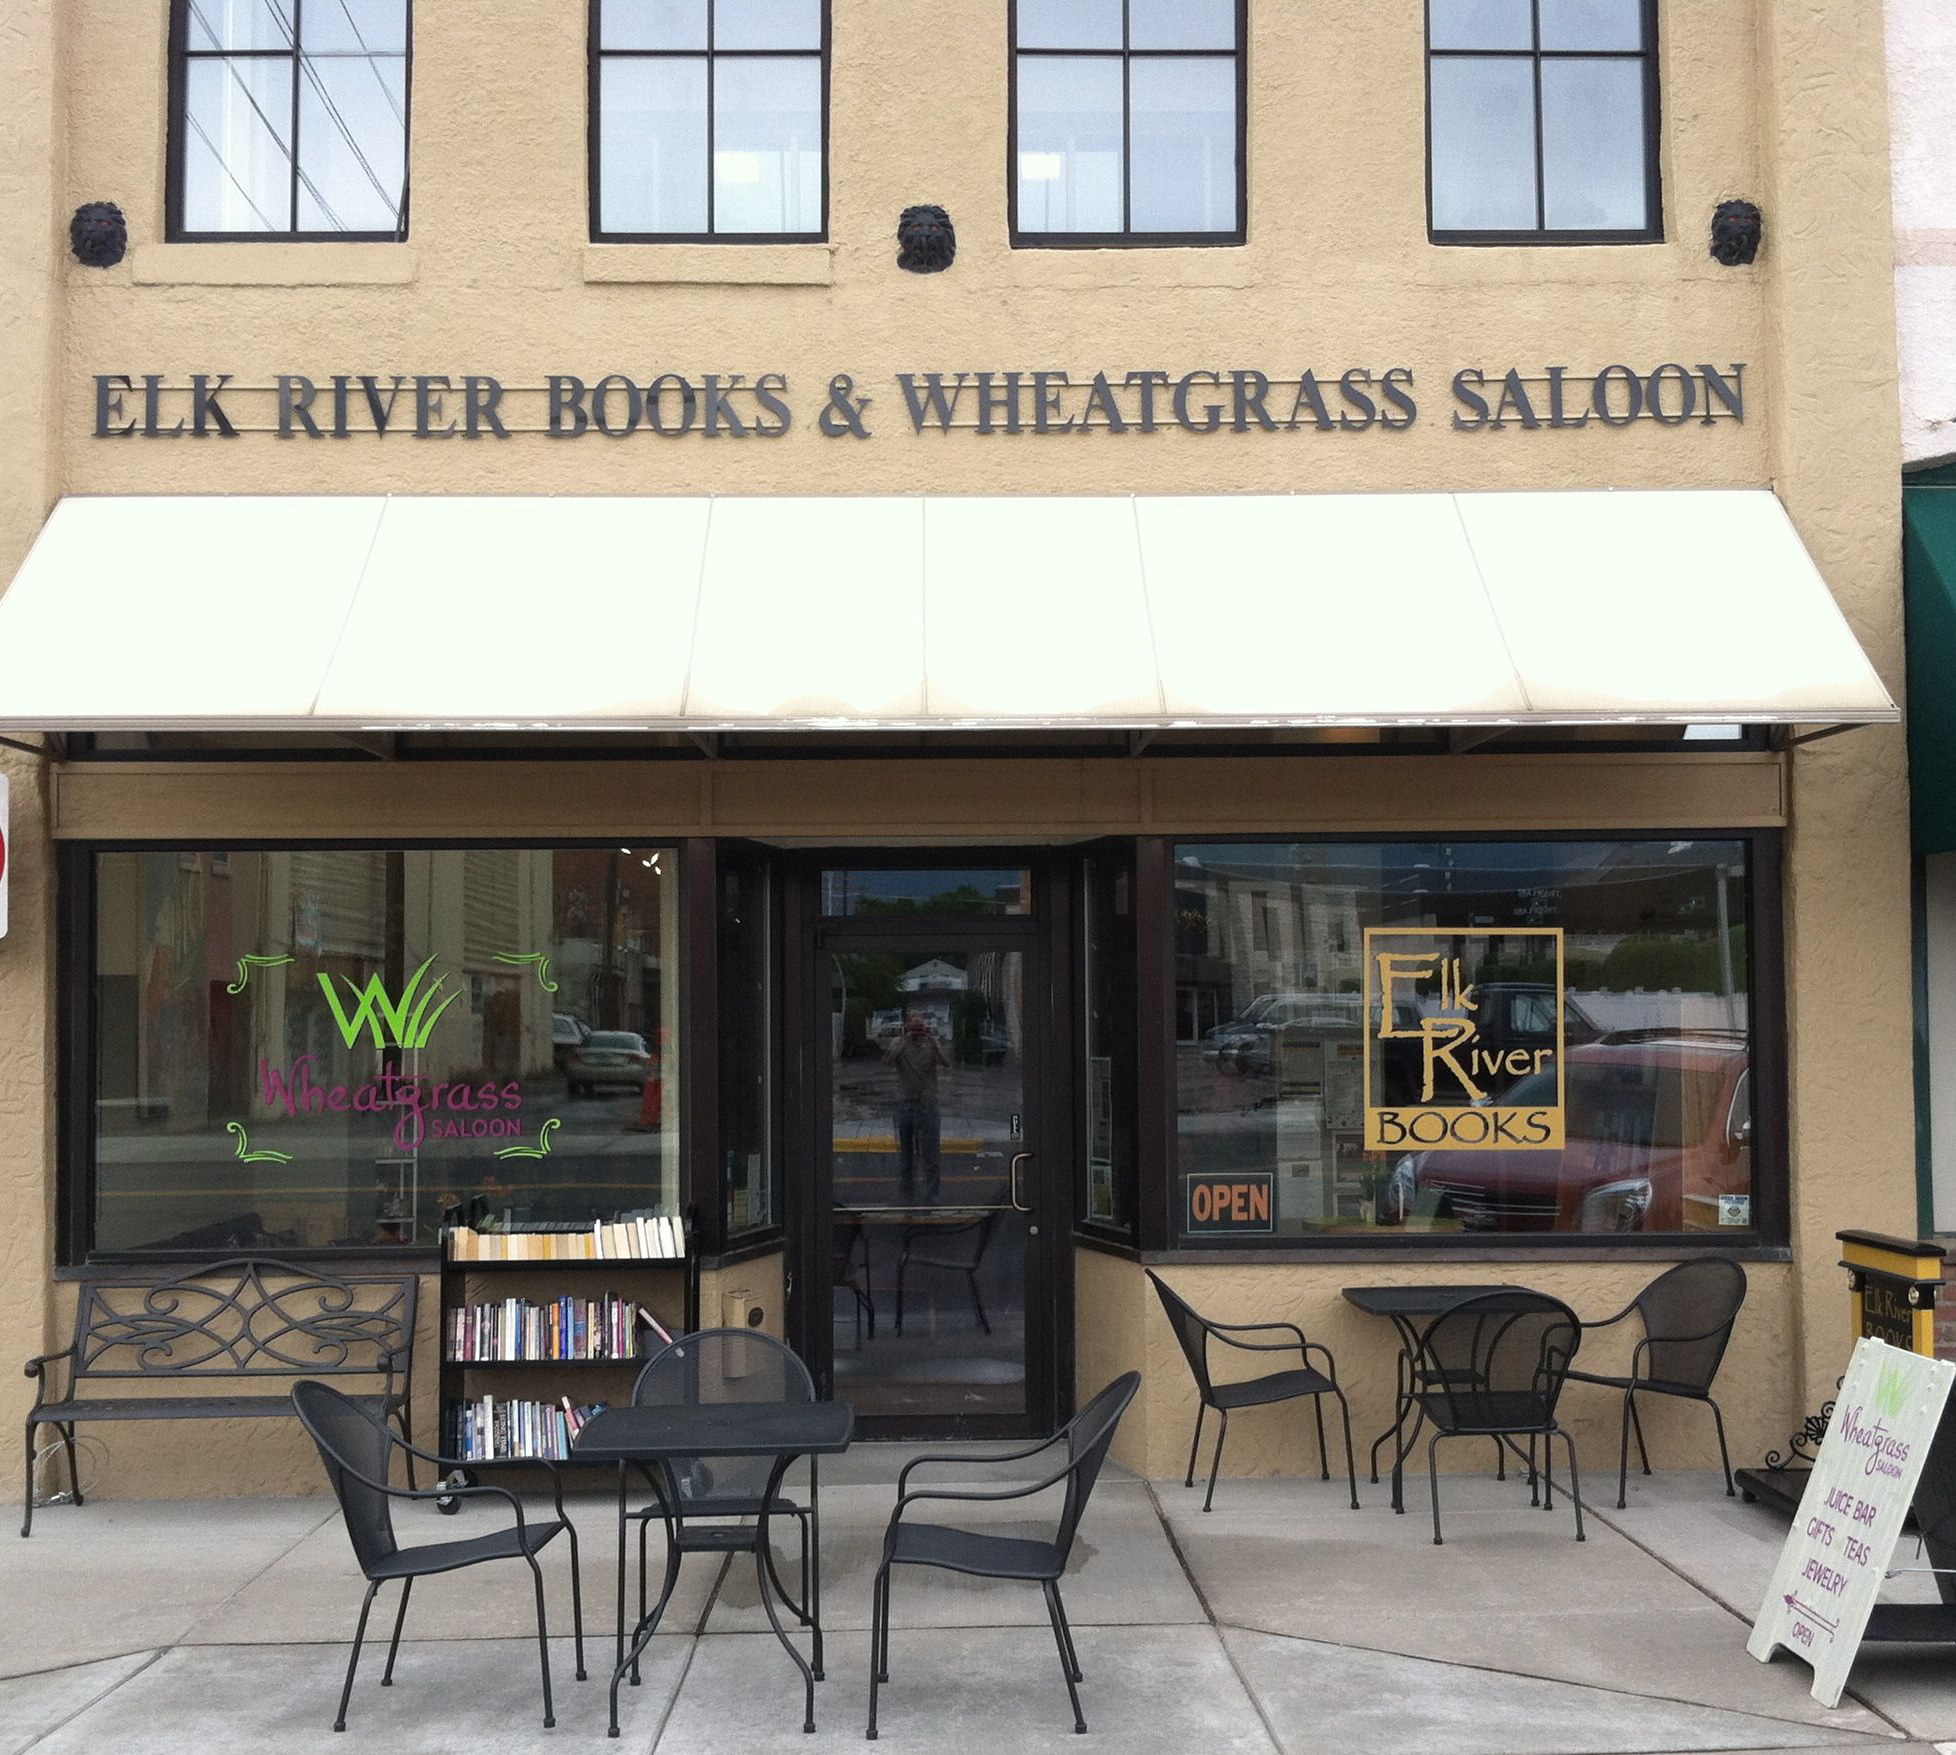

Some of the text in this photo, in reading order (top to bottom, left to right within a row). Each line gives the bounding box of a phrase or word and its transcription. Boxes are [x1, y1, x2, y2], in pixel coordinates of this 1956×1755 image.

[92, 362, 1747, 440] ELK RIVER BOOKS & WHEATGRASS SALOON
[1375, 952, 1479, 1039] Elk
[1420, 1017, 1553, 1103] River
[259, 1055, 522, 1150] Wheatgrass
[432, 1118, 523, 1138] SALOON
[1376, 1110, 1551, 1145] BOOKS
[1192, 1184, 1268, 1222] OPEN
[1840, 1404, 1910, 1475] Wheatgrass
[1875, 1459, 1903, 1479] SALOON
[1824, 1487, 1877, 1528] JUICE BAR
[1806, 1516, 1872, 1567] GIFTS TEAS
[1802, 1557, 1848, 1597] JEWELRY
[1792, 1621, 1815, 1647] OPEN
